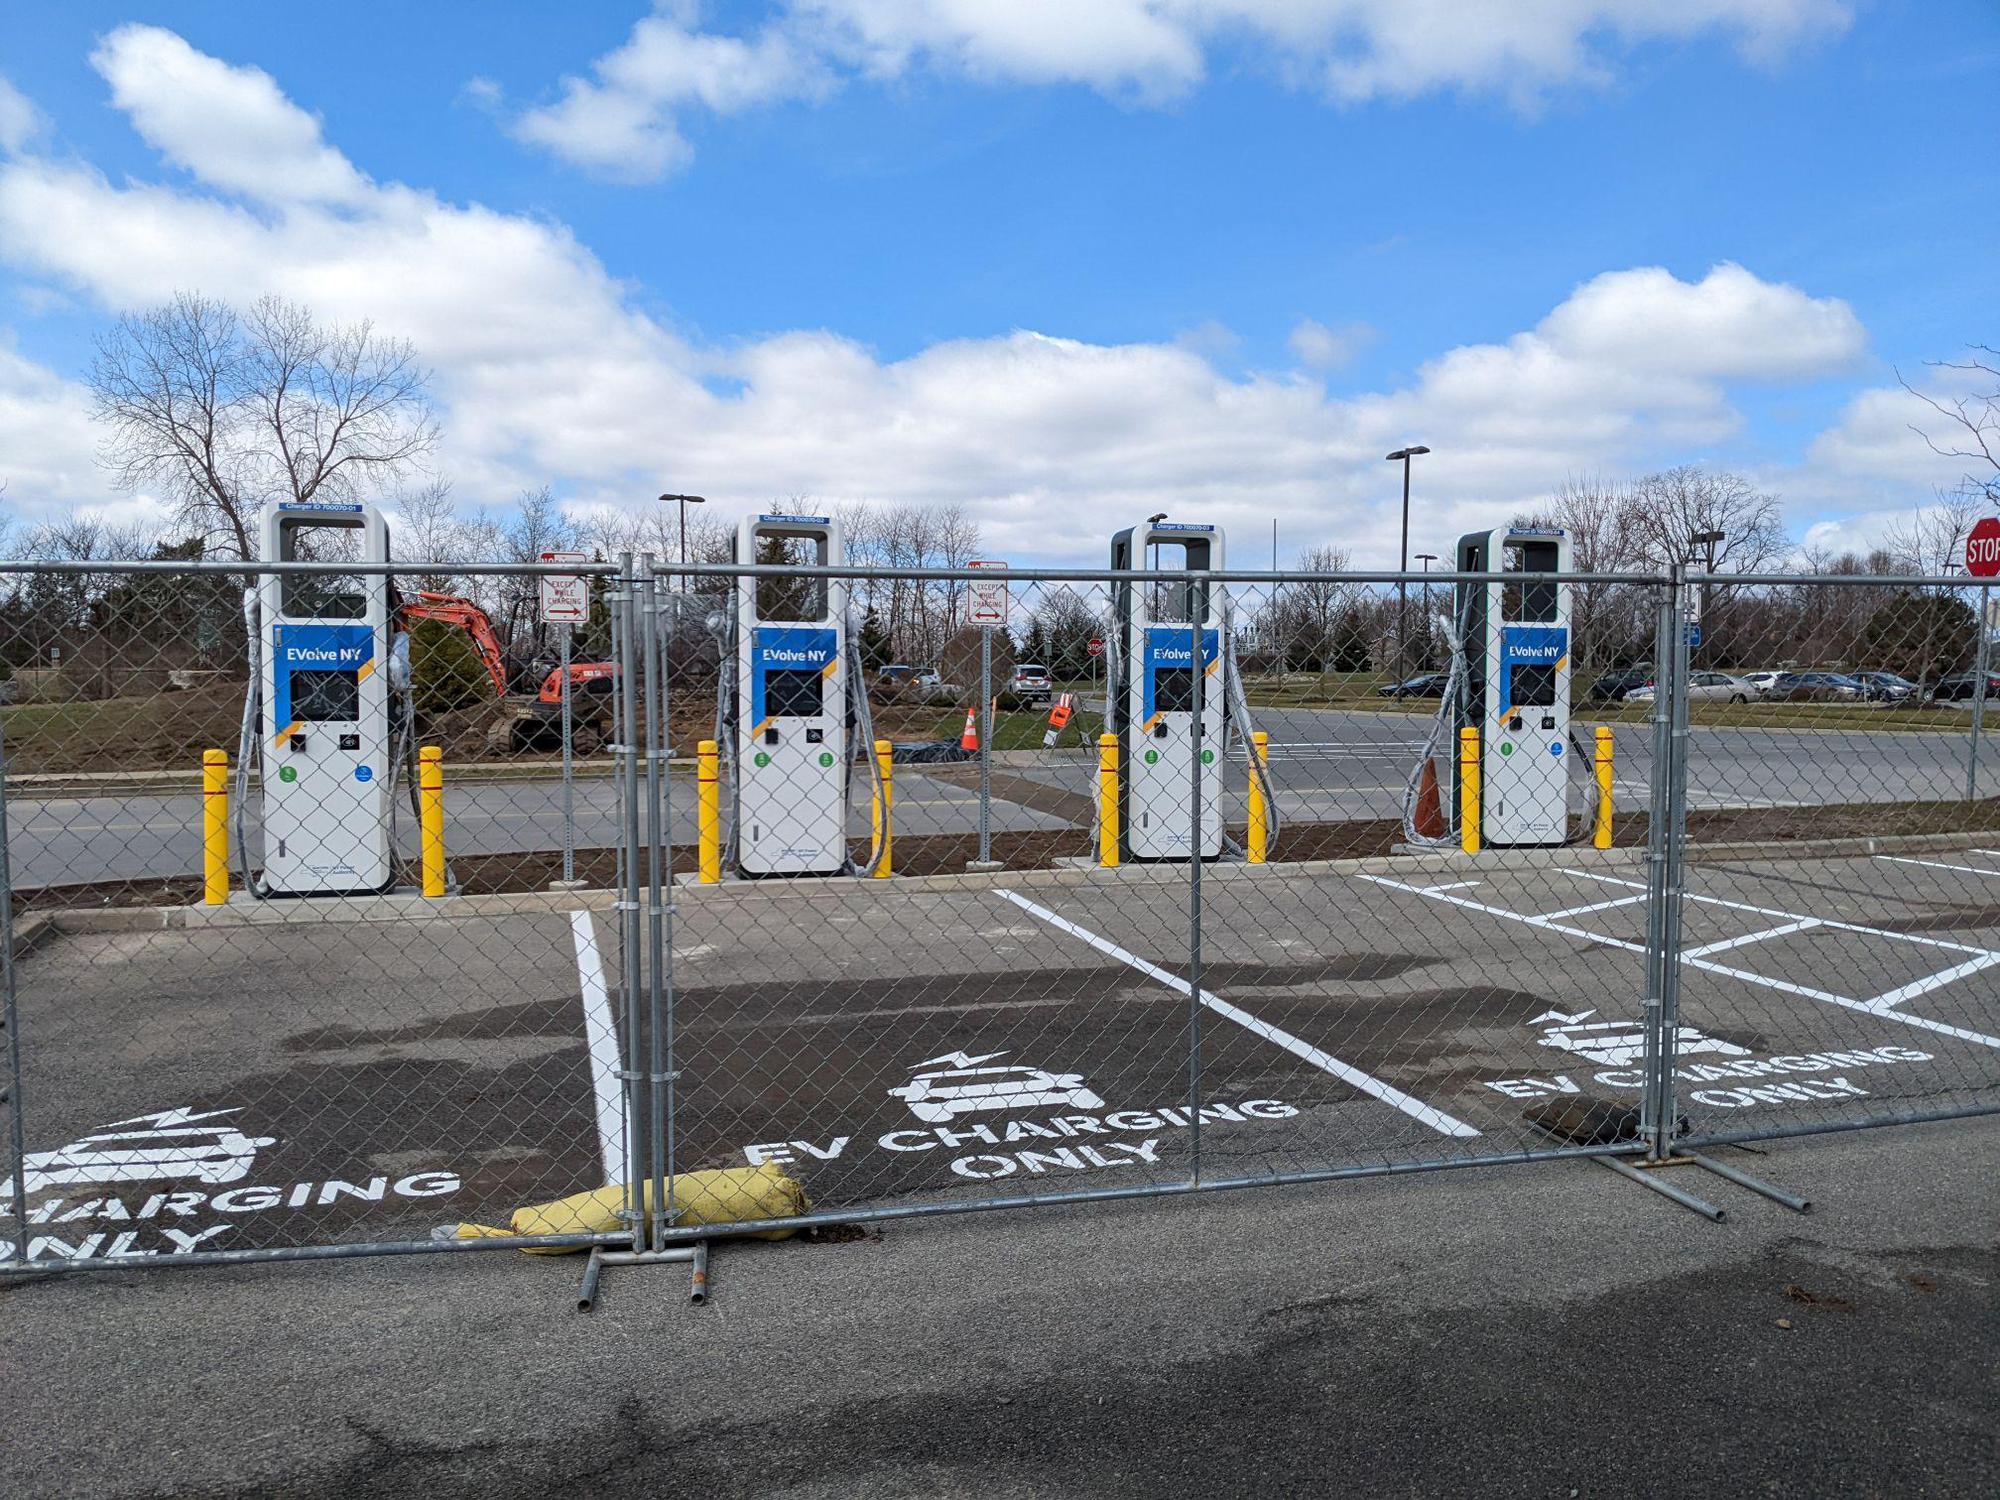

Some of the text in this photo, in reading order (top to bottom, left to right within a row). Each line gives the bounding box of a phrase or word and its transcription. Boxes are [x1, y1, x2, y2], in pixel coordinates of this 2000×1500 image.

[1968, 537, 2000, 563] STOP
[287, 647, 362, 661] EVolve NY
[763, 648, 828, 661] EVolve NY
[1153, 648, 1192, 660] EVolve
[1509, 646, 1560, 657] EVolve NY
[1484, 1046, 1935, 1098] EV CARGING
[1690, 1077, 1870, 1107] ONLY
[743, 1099, 1300, 1167] EV CHARGING
[950, 1139, 1160, 1180] ONLY
[0, 1225, 234, 1261] NLY
